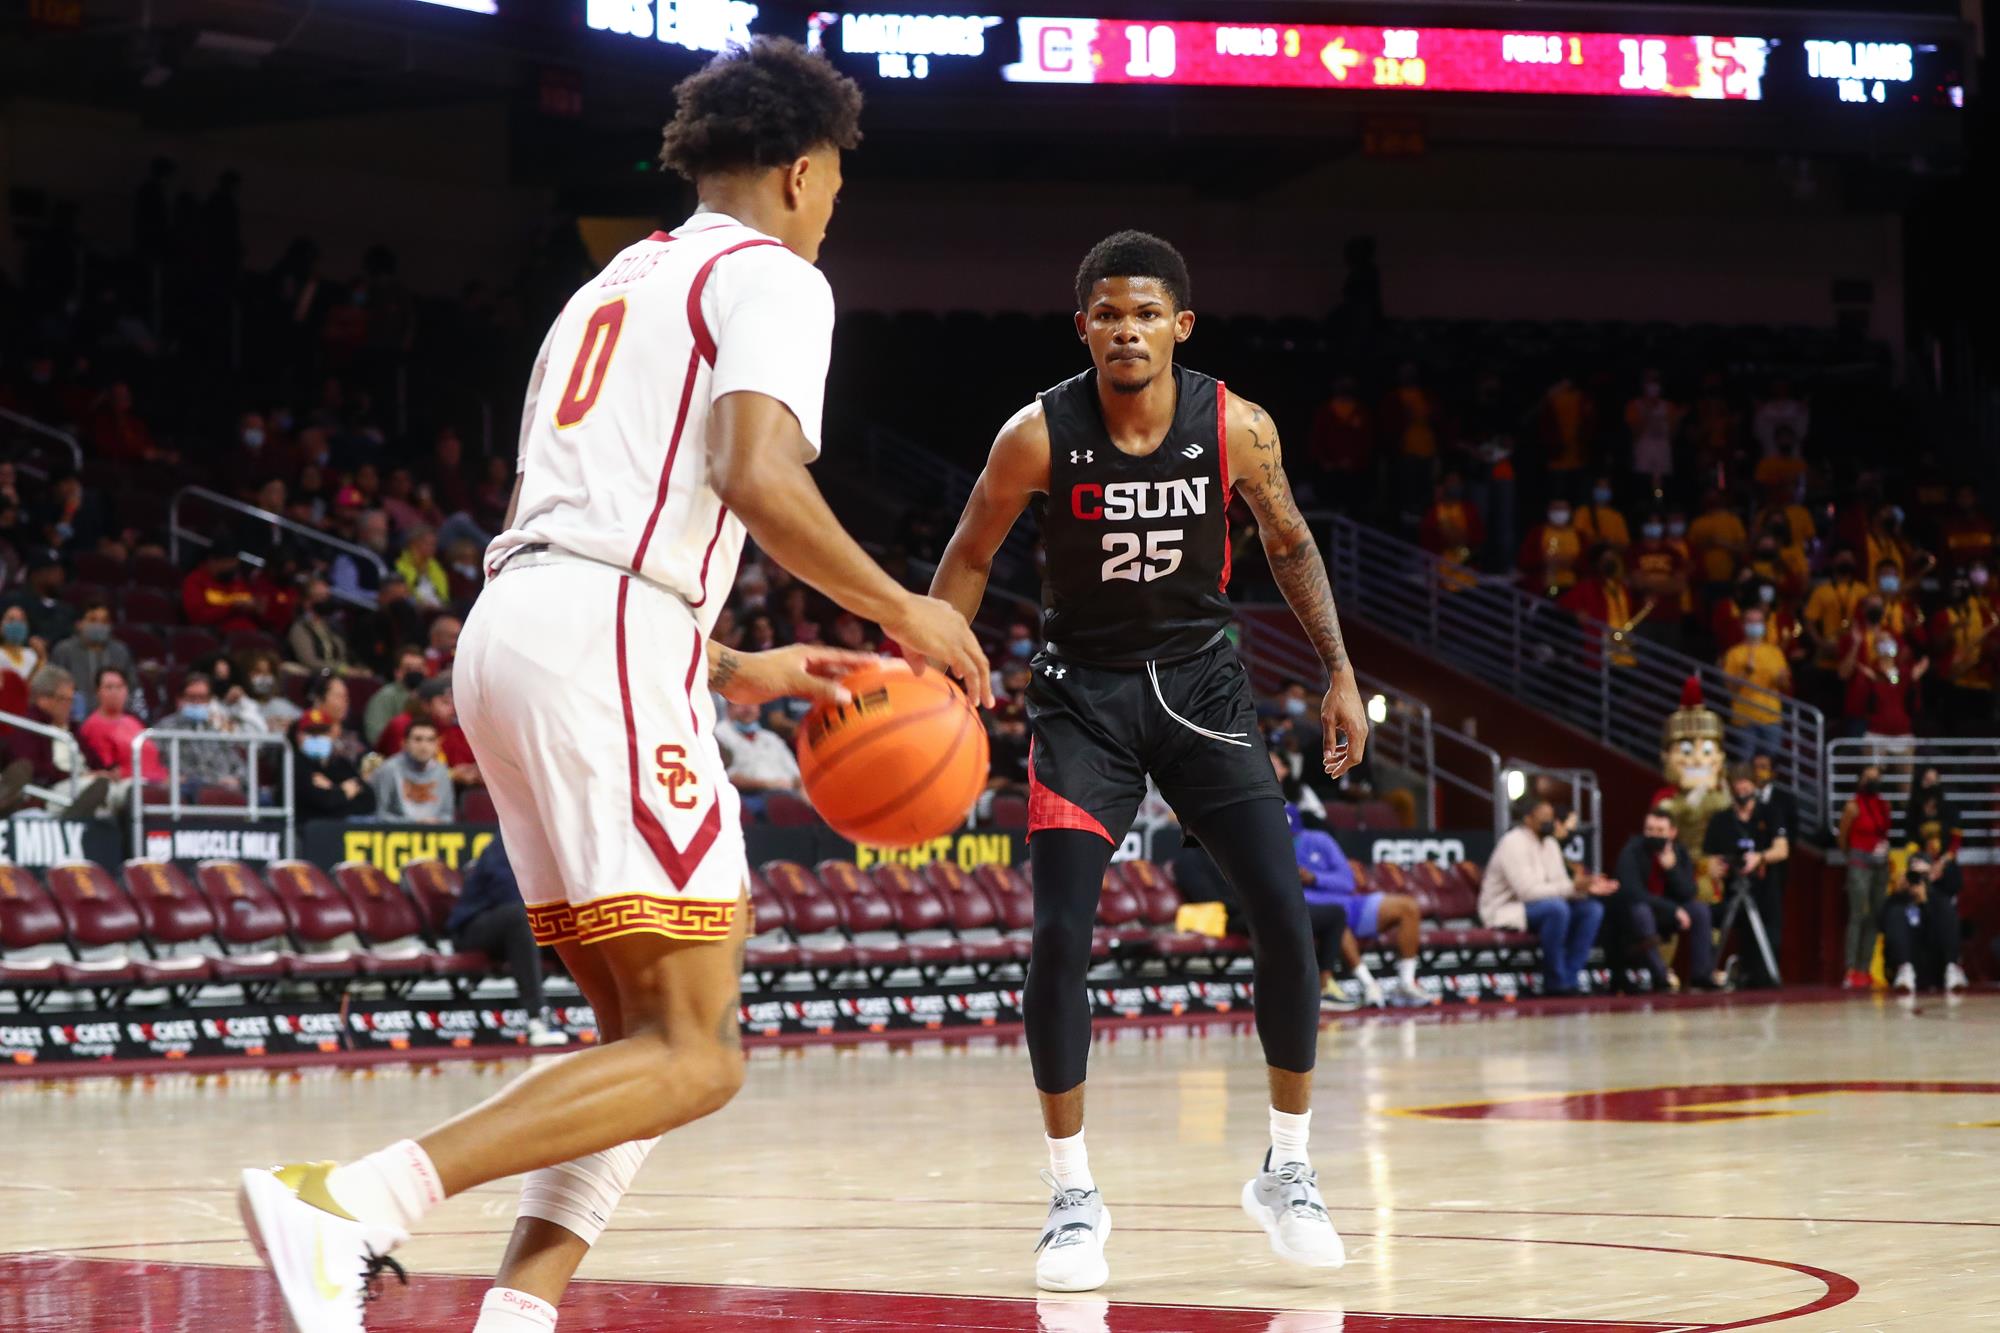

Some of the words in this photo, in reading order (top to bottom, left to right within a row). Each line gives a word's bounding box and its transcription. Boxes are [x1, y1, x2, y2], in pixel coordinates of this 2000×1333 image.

[554, 295, 628, 430] 0
[1071, 476, 1209, 521] CSUN
[1101, 529, 1184, 583] 25
[14, 819, 85, 868] MILK
[174, 830, 240, 860] MUSCLE
[241, 831, 280, 860] MILK
[344, 831, 465, 885] FIGHT
[856, 834, 953, 872] FHT
